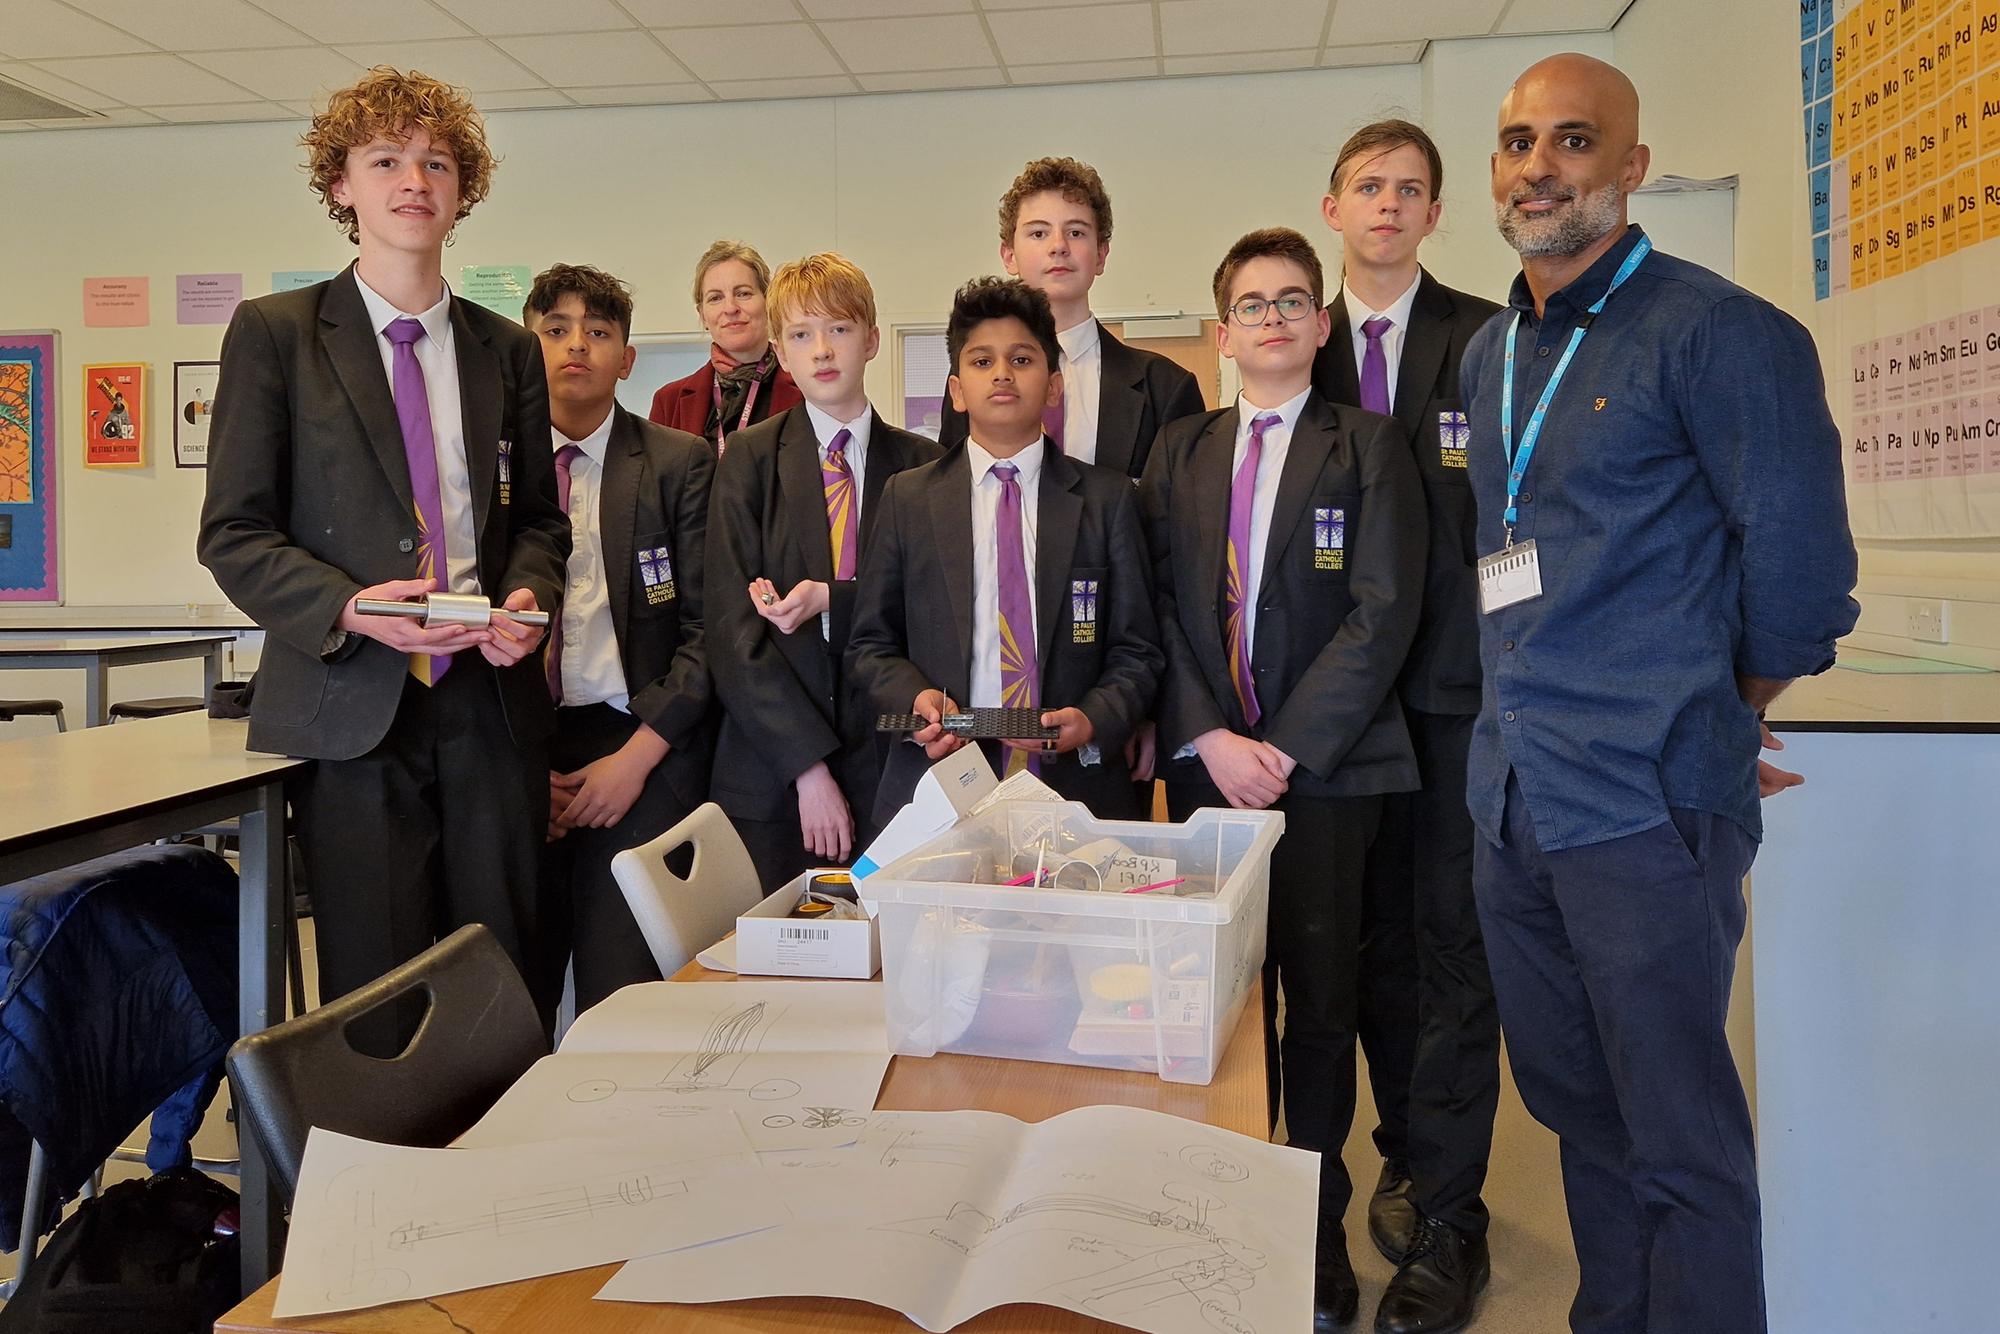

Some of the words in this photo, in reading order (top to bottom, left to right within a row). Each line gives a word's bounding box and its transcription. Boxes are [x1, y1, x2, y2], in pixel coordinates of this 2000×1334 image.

[1868, 20, 1875, 36] V
[1885, 9, 1895, 26] Cr
[1816, 122, 1829, 138] Sr
[1838, 112, 1844, 127] Y
[1852, 101, 1861, 119] Zr
[1865, 90, 1878, 110] Nb
[1883, 80, 1899, 99] Mo
[1903, 68, 1914, 86] Tc
[1919, 56, 1934, 75] Ru
[1938, 41, 1950, 64] Rh
[1955, 24, 1971, 50] Pd
[1980, 12, 1998, 36] Ag
[1814, 191, 1827, 207] Ba
[1852, 171, 1861, 191] Hf
[1868, 165, 1878, 182] Ta
[1885, 153, 1897, 172] W
[1904, 146, 1917, 163] Re
[1920, 135, 1935, 153] Os
[1955, 112, 1968, 133] Pt
[1982, 100, 2000, 121] Au
[1815, 258, 1827, 273] Ra
[1853, 243, 1863, 260] Rf
[1869, 236, 1879, 254] Db
[1886, 229, 1899, 248] Sg
[1906, 221, 1919, 239] Bh
[1921, 214, 1935, 232] Hs
[1943, 203, 1954, 223] Mt
[1958, 196, 1975, 214] Ds
[1630, 243, 1648, 264] VISITOR
[1855, 368, 1865, 383] La
[1870, 363, 1879, 379] Ce
[1890, 358, 1902, 375] Pr
[1909, 353, 1920, 372] Nd
[1923, 350, 1938, 367] Pm
[1940, 344, 1956, 362] Sm
[1961, 339, 1978, 357] Eu
[121, 424, 135, 439] 92
[1524, 421, 1539, 448] VISITOR
[1855, 438, 1868, 453] Ac
[1888, 433, 1902, 450] Pa
[1912, 430, 1920, 447] U
[1925, 428, 1940, 449] Np
[1946, 425, 1958, 443] Pu
[1962, 423, 1980, 440] Am
[183, 445, 205, 453] SCIENCE
[1315, 562, 1344, 570] COLLEGE
[646, 587, 675, 599] CATHOLIC
[653, 581, 674, 591] PAUL'S
[648, 592, 676, 605] COLLEGE
